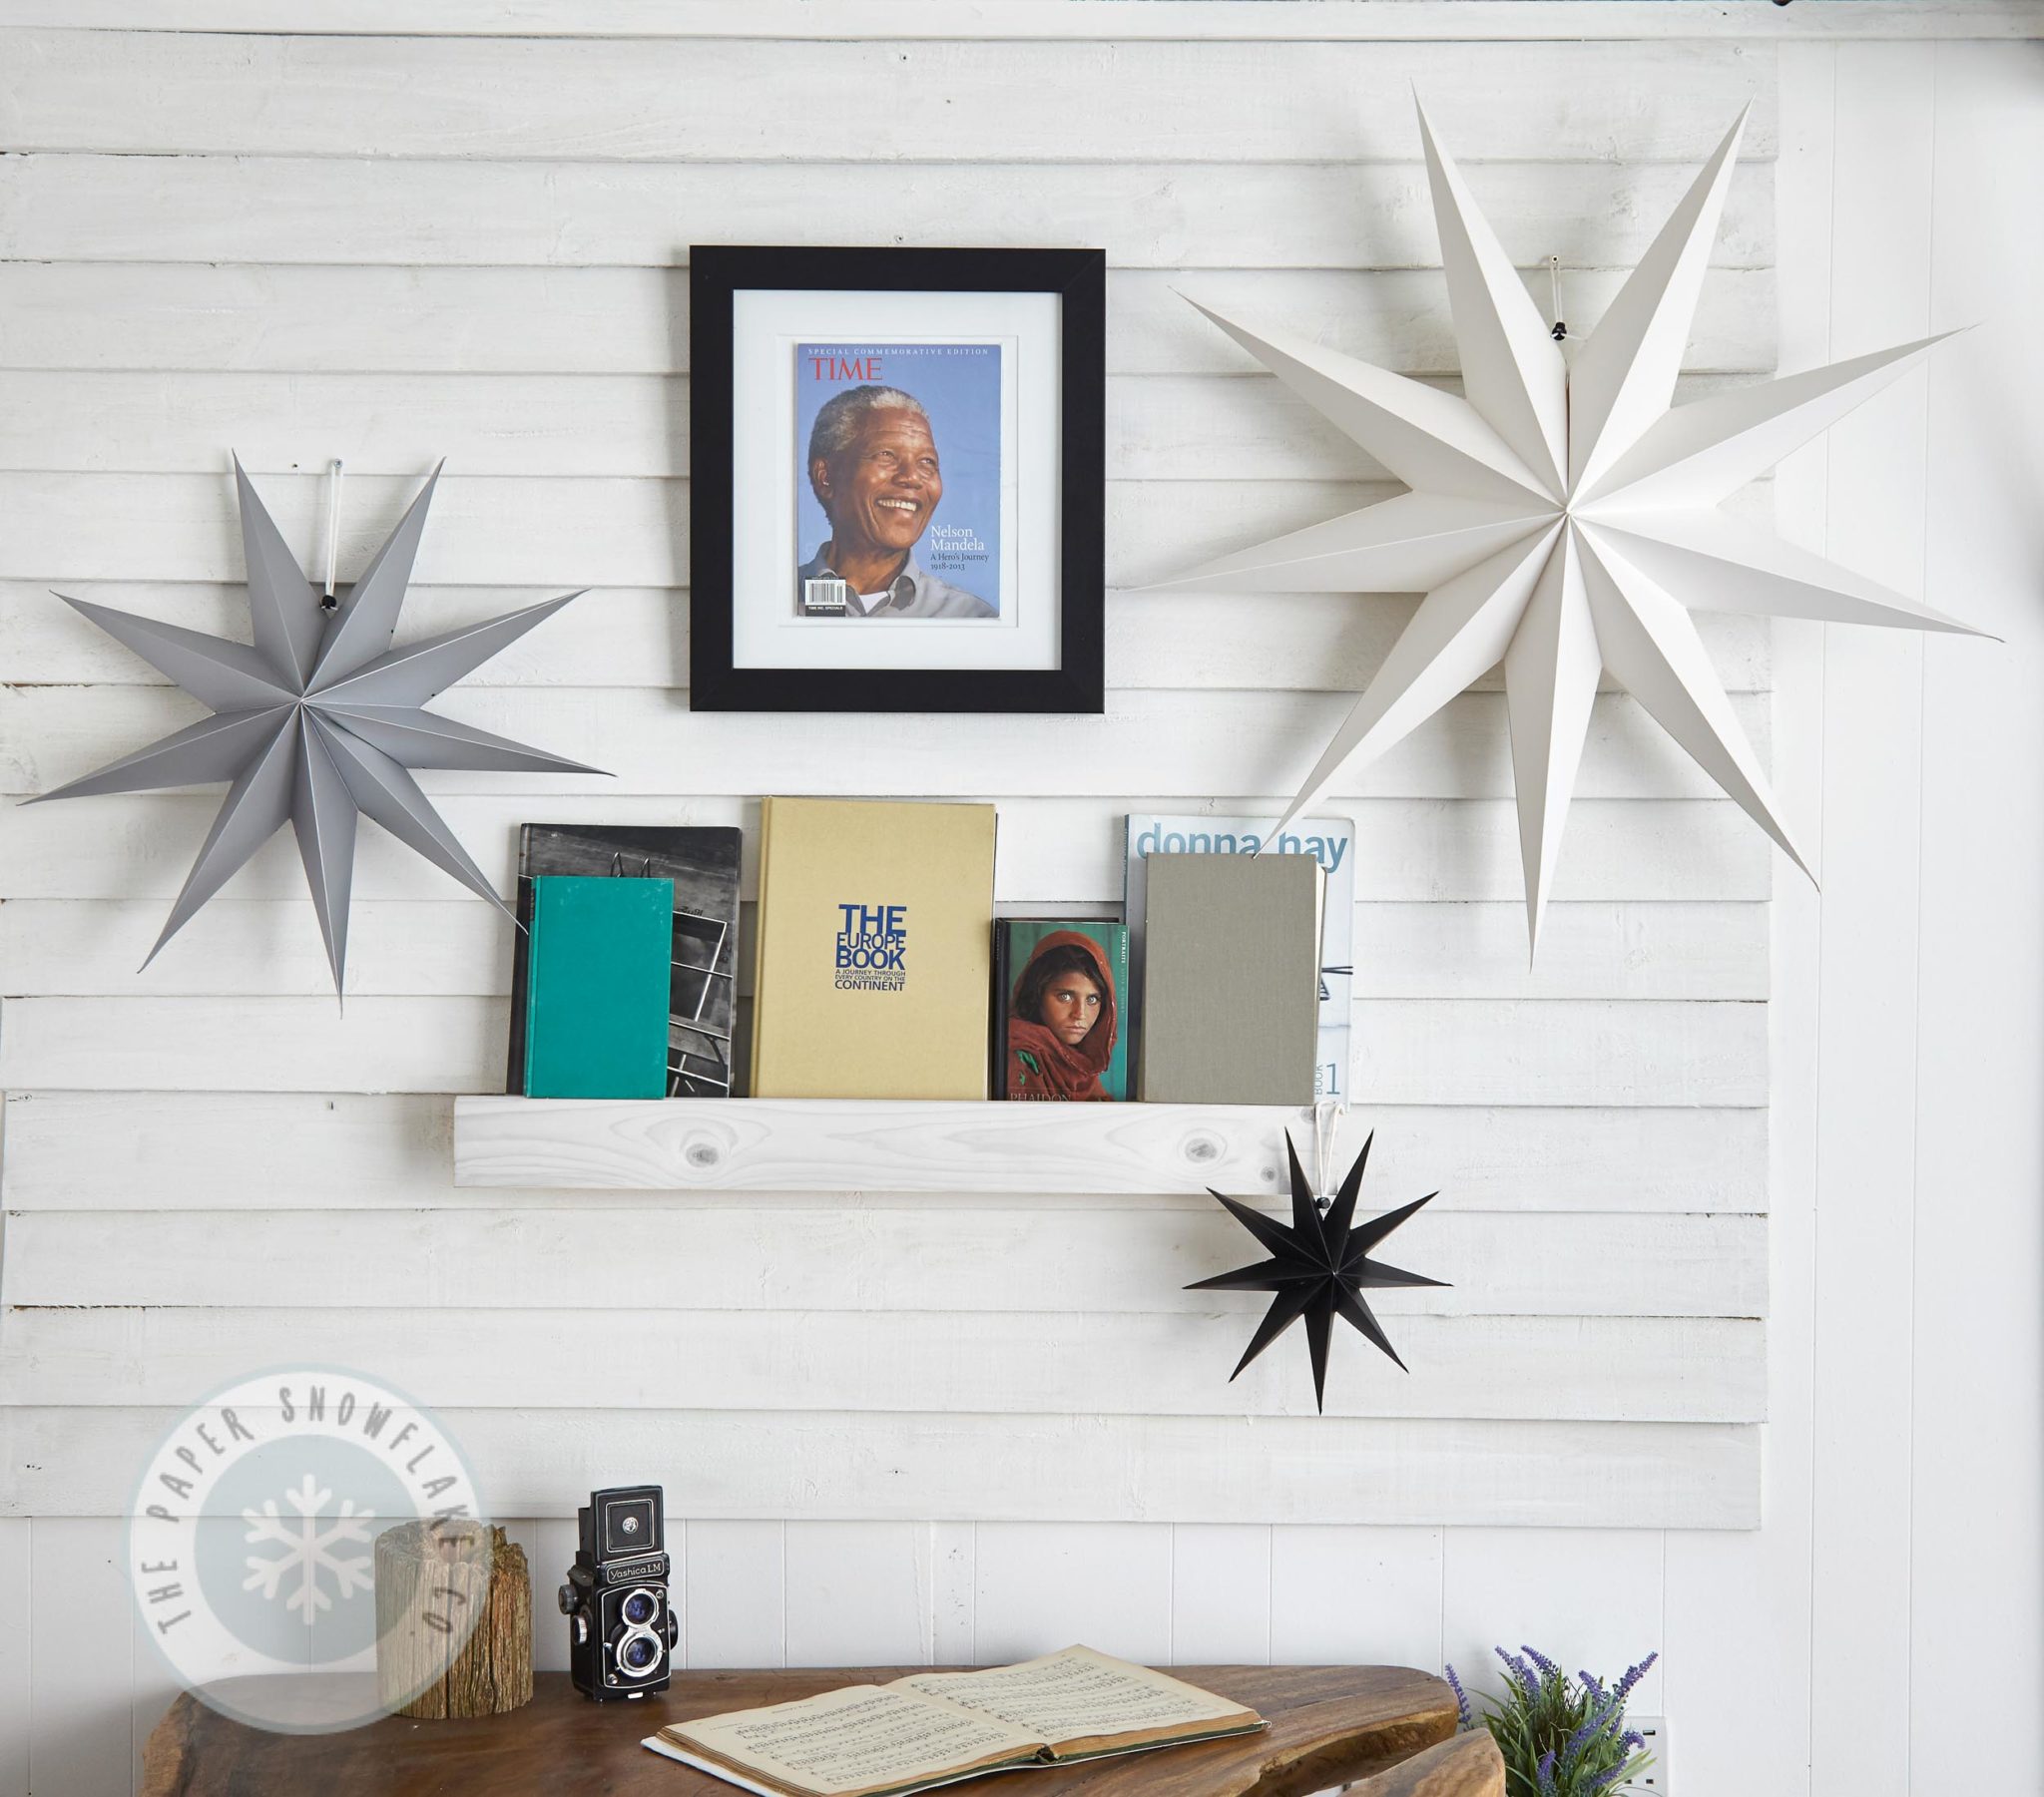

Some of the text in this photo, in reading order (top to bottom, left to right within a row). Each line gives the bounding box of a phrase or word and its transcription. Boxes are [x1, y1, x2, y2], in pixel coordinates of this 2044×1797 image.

[808, 357, 883, 381] TIME
[931, 524, 973, 538] Nelson
[931, 537, 985, 551] Mandela
[931, 562, 966, 571] 1918-2013
[961, 553, 989, 563] Journey
[1137, 822, 1262, 859] donna
[1278, 831, 1348, 874] hay
[838, 904, 907, 937] THE
[836, 932, 905, 950] EUROPE
[835, 946, 906, 970] BOOK
[834, 980, 906, 991] CONTINENT
[1326, 1063, 1340, 1095] 1
